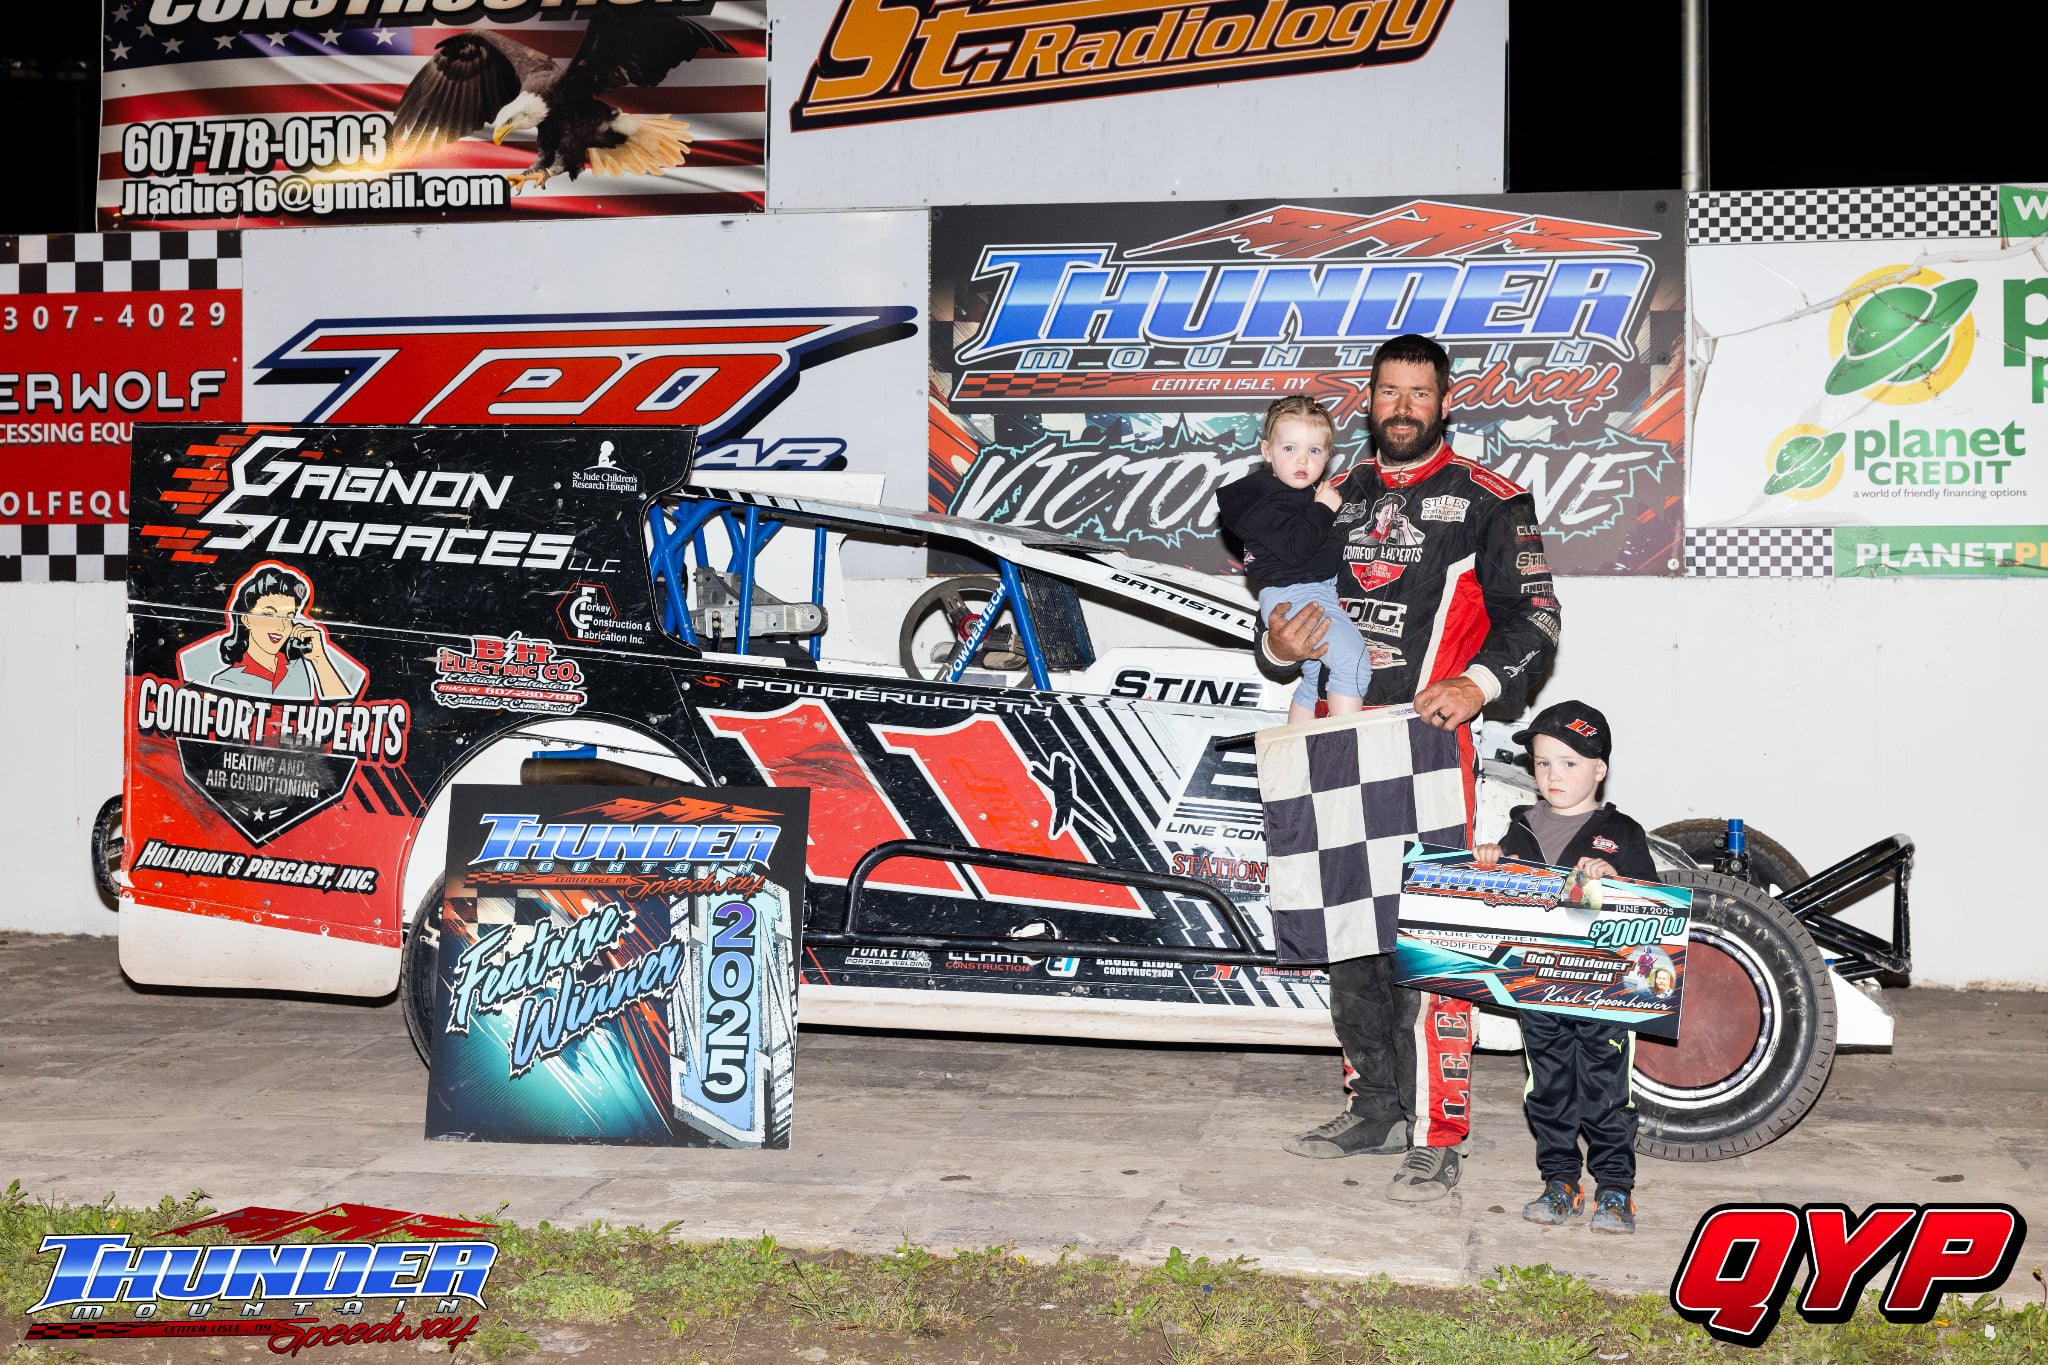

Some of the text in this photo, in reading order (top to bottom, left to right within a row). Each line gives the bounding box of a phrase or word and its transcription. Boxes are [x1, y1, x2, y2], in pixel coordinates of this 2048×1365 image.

[1003, 0, 1456, 81] Radiology
[124, 117, 388, 173] 607-778-0503
[4, 302, 226, 331] 307-4029
[955, 243, 1652, 361] THUNDER
[1016, 340, 1592, 371] MOUNTIN
[1151, 377, 1312, 391] CENTER LISLE, NY
[1313, 361, 1620, 428] Spdway
[690, 442, 843, 468] AR
[1855, 419, 2026, 470] planet
[231, 436, 513, 509] GAGNON
[572, 479, 637, 493] Research Hospital
[583, 472, 600, 482] Jude
[601, 473, 638, 483] Children's
[1868, 460, 2012, 486] CREDIT
[1424, 496, 1467, 510] STILES
[1861, 488, 1889, 498] world
[1891, 488, 1902, 498] of
[1903, 488, 1940, 499] friendly
[1943, 488, 1987, 499] financing
[1990, 488, 2027, 499] options
[199, 489, 576, 570] SURFACES
[1342, 545, 1378, 561] COMFO
[1110, 573, 1231, 621] BATTISTI
[629, 632, 645, 645] Inc.
[441, 652, 580, 682] ELECTRIC CO.
[737, 678, 1053, 717] POWDERWORTH
[1110, 670, 1263, 707] STINE
[138, 678, 406, 756] COMFORT EXPERTS
[223, 751, 305, 777] HEATING AND
[205, 770, 319, 799] AIR CONDITIONING
[467, 813, 782, 870] THUNDER
[1165, 822, 1217, 837] LINE
[134, 840, 376, 892] HOLBROOK'S PRECAST, INC.
[493, 861, 754, 874] MOUNTAIN
[1171, 853, 1267, 884] STATION
[1405, 861, 1566, 899] THUNDER
[625, 874, 766, 901] Speedway
[1615, 905, 1674, 916] JUNE 7, 2025
[1409, 928, 1539, 943] FEATURE WINNER
[1430, 939, 1494, 952] MODIFIEDS
[457, 908, 621, 1024] Feature
[945, 961, 1031, 973] CONSTRUCTION
[1103, 966, 1174, 978] CONSTRUCTION
[1525, 953, 1556, 965] Bob
[1538, 967, 1613, 983] Memorial
[512, 942, 685, 1067] Winner
[703, 902, 757, 1102] 2025
[1541, 985, 1672, 1011] Karl Spoonhower
